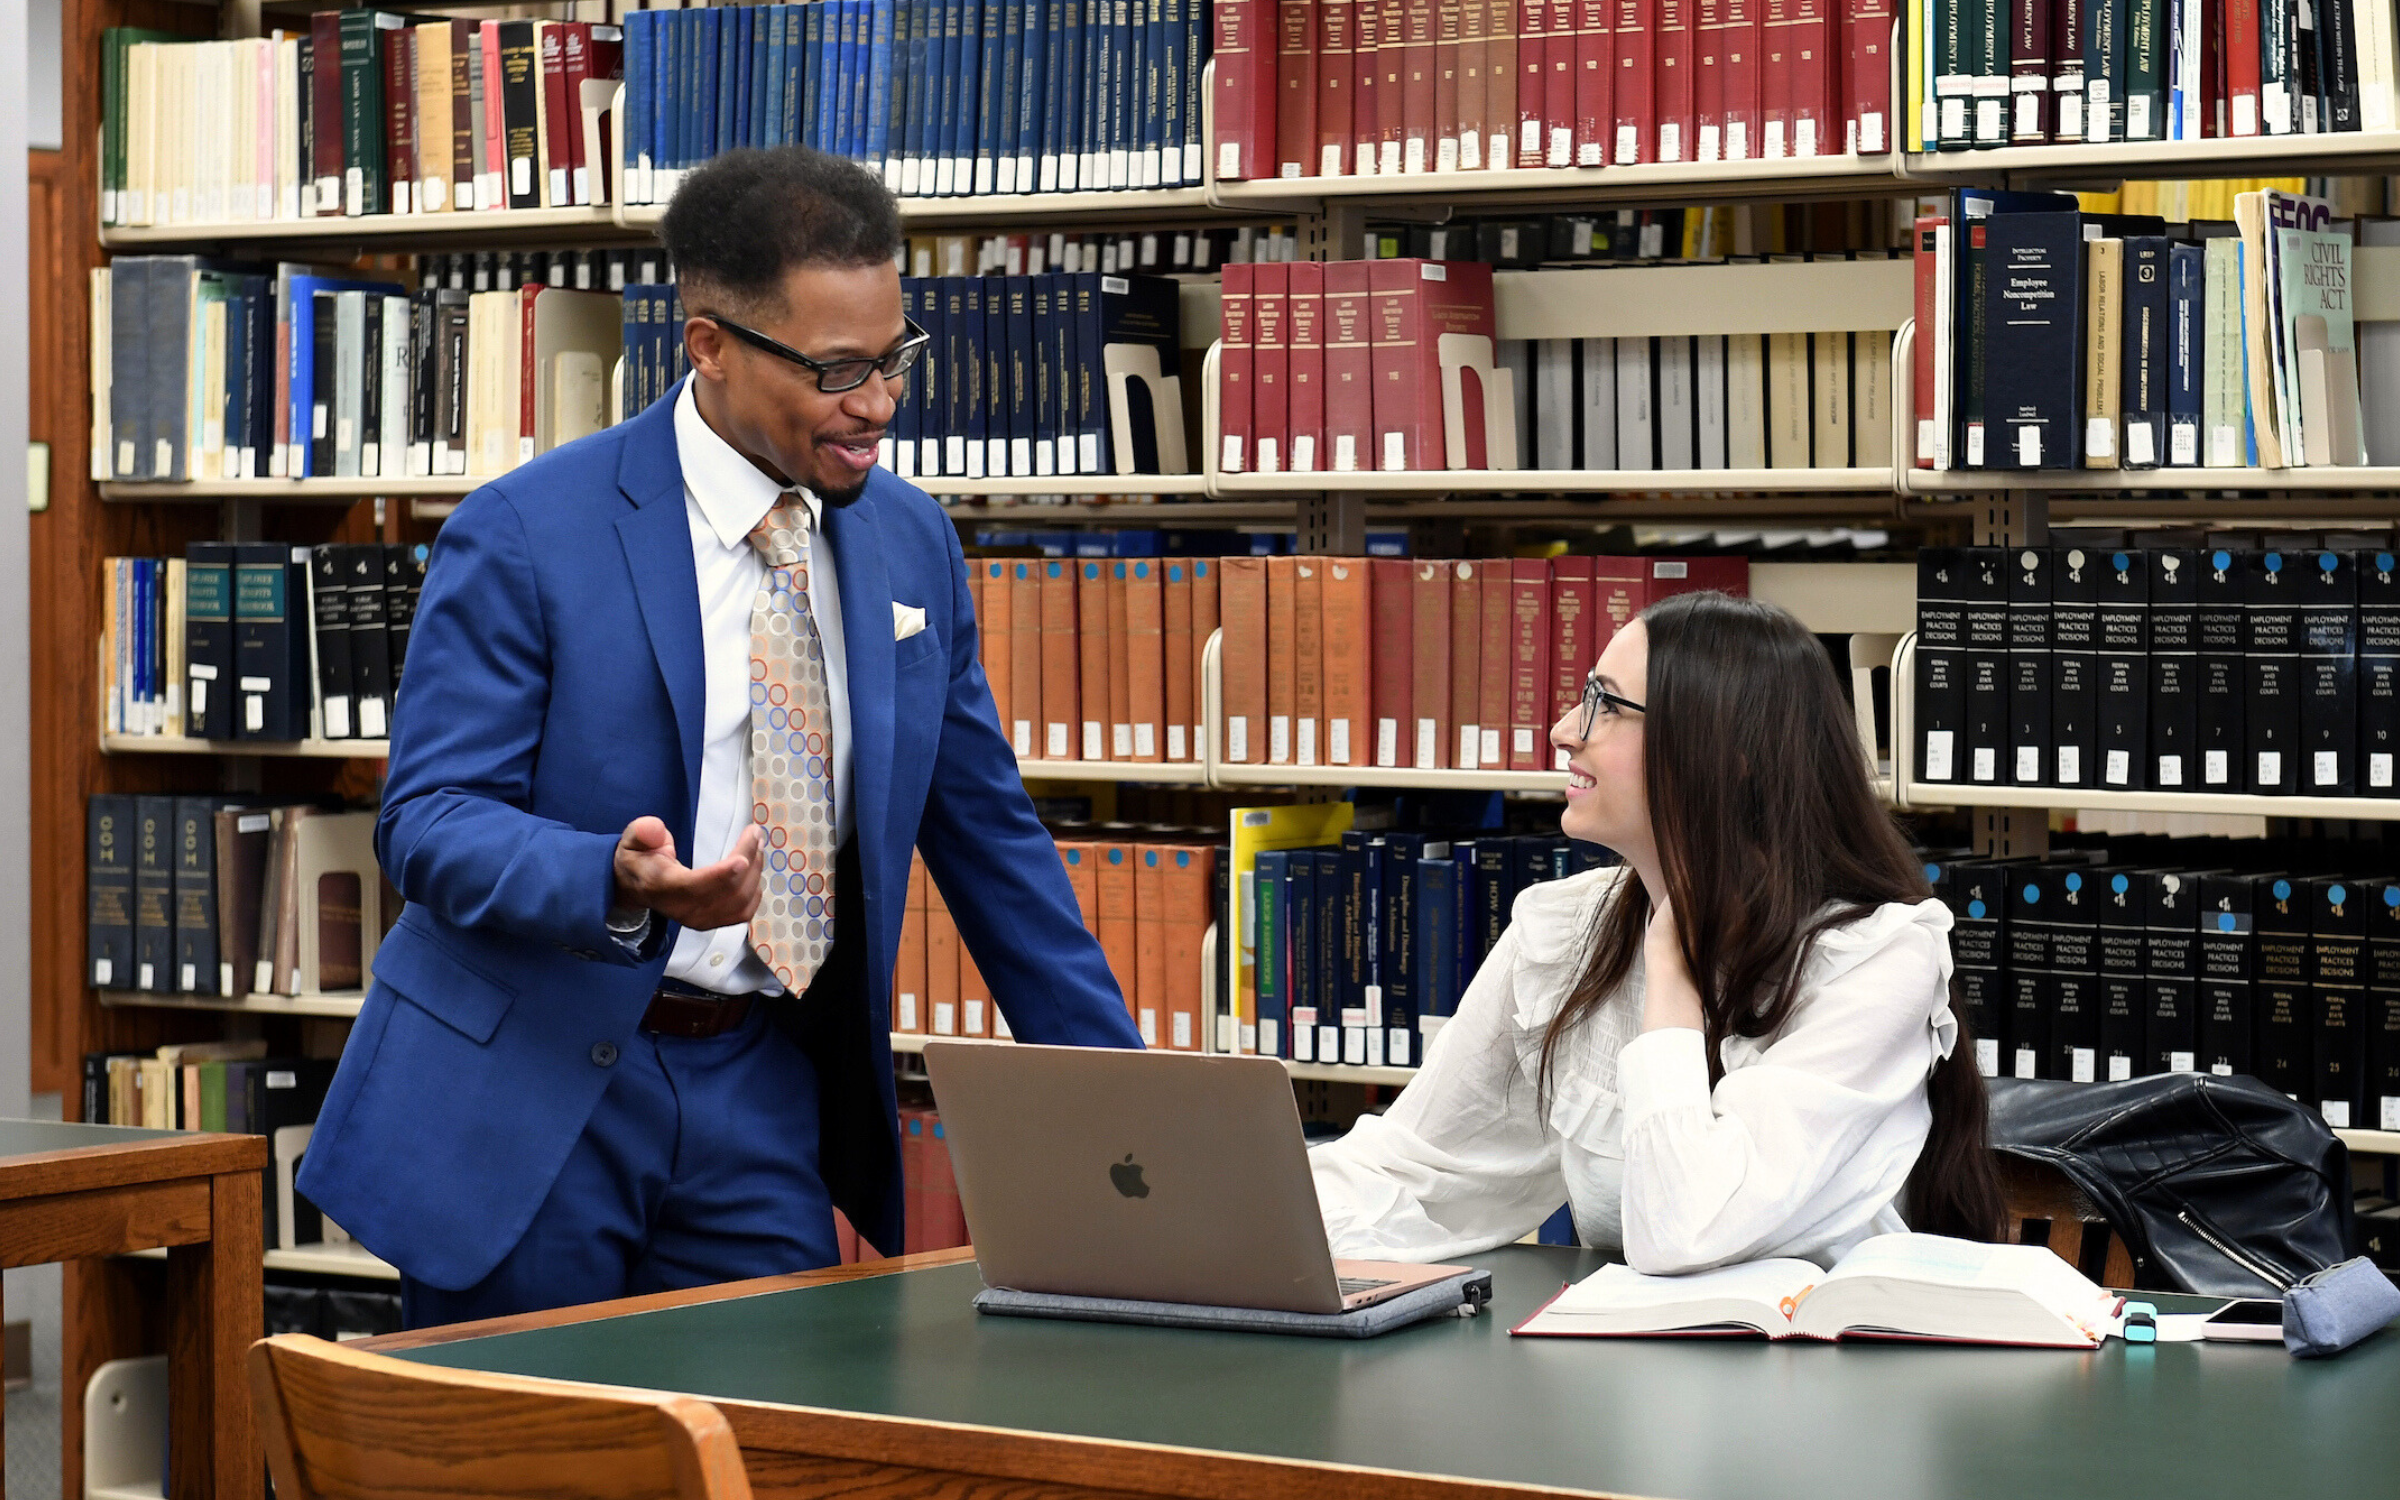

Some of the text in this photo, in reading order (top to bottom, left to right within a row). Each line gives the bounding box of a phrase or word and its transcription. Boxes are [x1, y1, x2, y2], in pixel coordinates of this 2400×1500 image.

[2024, 28, 2032, 50] LAW
[2067, 28, 2075, 50] LAW
[2102, 55, 2111, 77] LAW
[2139, 52, 2150, 73] LAW
[1949, 63, 1958, 75] LA
[1985, 62, 1994, 75] LA
[2312, 243, 2345, 265] CIVIL
[2304, 264, 2346, 288] RIGHTS
[2010, 277, 2048, 289] Employee
[2003, 289, 2055, 300] Noncompetition
[2320, 289, 2346, 311] ACT
[2021, 302, 2037, 310] Law
[2096, 271, 2106, 415] LABOR RELATIONS AND SOCIAL PROBLEMS
[1921, 611, 1961, 620] EMPLOYMENT
[1968, 612, 2006, 621] EMPLOYMENT
[2009, 614, 2049, 622] EMPLOYMENT
[2054, 612, 2094, 621] EMPLOYMENT
[2102, 614, 2141, 623] EMPLOYMENT
[2151, 615, 2191, 623] EMPLOYMENT
[2200, 614, 2241, 622] EMPLOYMENT
[1926, 622, 1956, 630] PRACTICES
[1972, 623, 2002, 631] PRACTICES
[2058, 622, 2090, 631] PRACTICES
[2106, 625, 2137, 633] PRACTICES
[2204, 625, 2236, 633] PRACTICES
[2255, 626, 2287, 634] PRACTICES
[2367, 626, 2400, 634] PRACTICES
[1925, 632, 1956, 641] DECISIONS
[1971, 633, 2002, 641] DECISIONS
[2013, 634, 2045, 642] DECISIONS
[2057, 632, 2090, 641] DECISIONS
[2105, 635, 2137, 643] DECISIONS
[2154, 636, 2187, 644] DECISIONS
[2203, 636, 2236, 644] DECISIONS
[2255, 637, 2288, 645] DECISIONS
[2309, 637, 2344, 645] DECISIONS
[2366, 637, 2400, 645] DECISIONS
[1936, 720, 1940, 730] 1
[2024, 724, 2030, 733] 3
[2067, 723, 2073, 732] 4
[2116, 725, 2122, 734] 5
[2167, 726, 2172, 736] 6
[2215, 727, 2221, 736] 7
[2267, 729, 2272, 739] 8
[2323, 730, 2329, 739] 9
[2377, 730, 2387, 741] 10
[1400, 875, 1410, 917] Discipline
[1490, 880, 1498, 911] HOW
[2052, 934, 2092, 944] EMPLOYMENT
[2102, 937, 2141, 946] EMPLOYMENT
[2149, 939, 2190, 948] EMPLOYMENT
[2014, 942, 2044, 951] PRACTICES
[2056, 945, 2086, 954] PRACTICES
[2203, 942, 2244, 951] EMPLOYMENT
[2262, 944, 2304, 954] EMPLOYMENT
[2317, 946, 2359, 955] EMPLOYMENT
[1400, 934, 1410, 975] Discharge
[2013, 952, 2044, 961] DECISIONS
[2105, 948, 2136, 957] PRACTICES
[2152, 950, 2184, 959] PRACTICES
[2056, 956, 2086, 965] DECISIONS
[2208, 953, 2238, 962] PRACTICES
[2267, 955, 2299, 964] PRACTICES
[2321, 957, 2354, 966] PRACTICES
[2105, 959, 2136, 967] DECISIONS
[2152, 961, 2185, 969] DECISIONS
[2207, 964, 2239, 973] DECISIONS
[2266, 966, 2300, 974] DECISIONS
[2320, 968, 2354, 977] DECISIONS
[2064, 1045, 2073, 1055] 20
[2161, 1052, 2171, 1061] 22
[2277, 1059, 2287, 1068] 24
[2330, 1063, 2340, 1072] 25
[2388, 1068, 2399, 1077] 26
